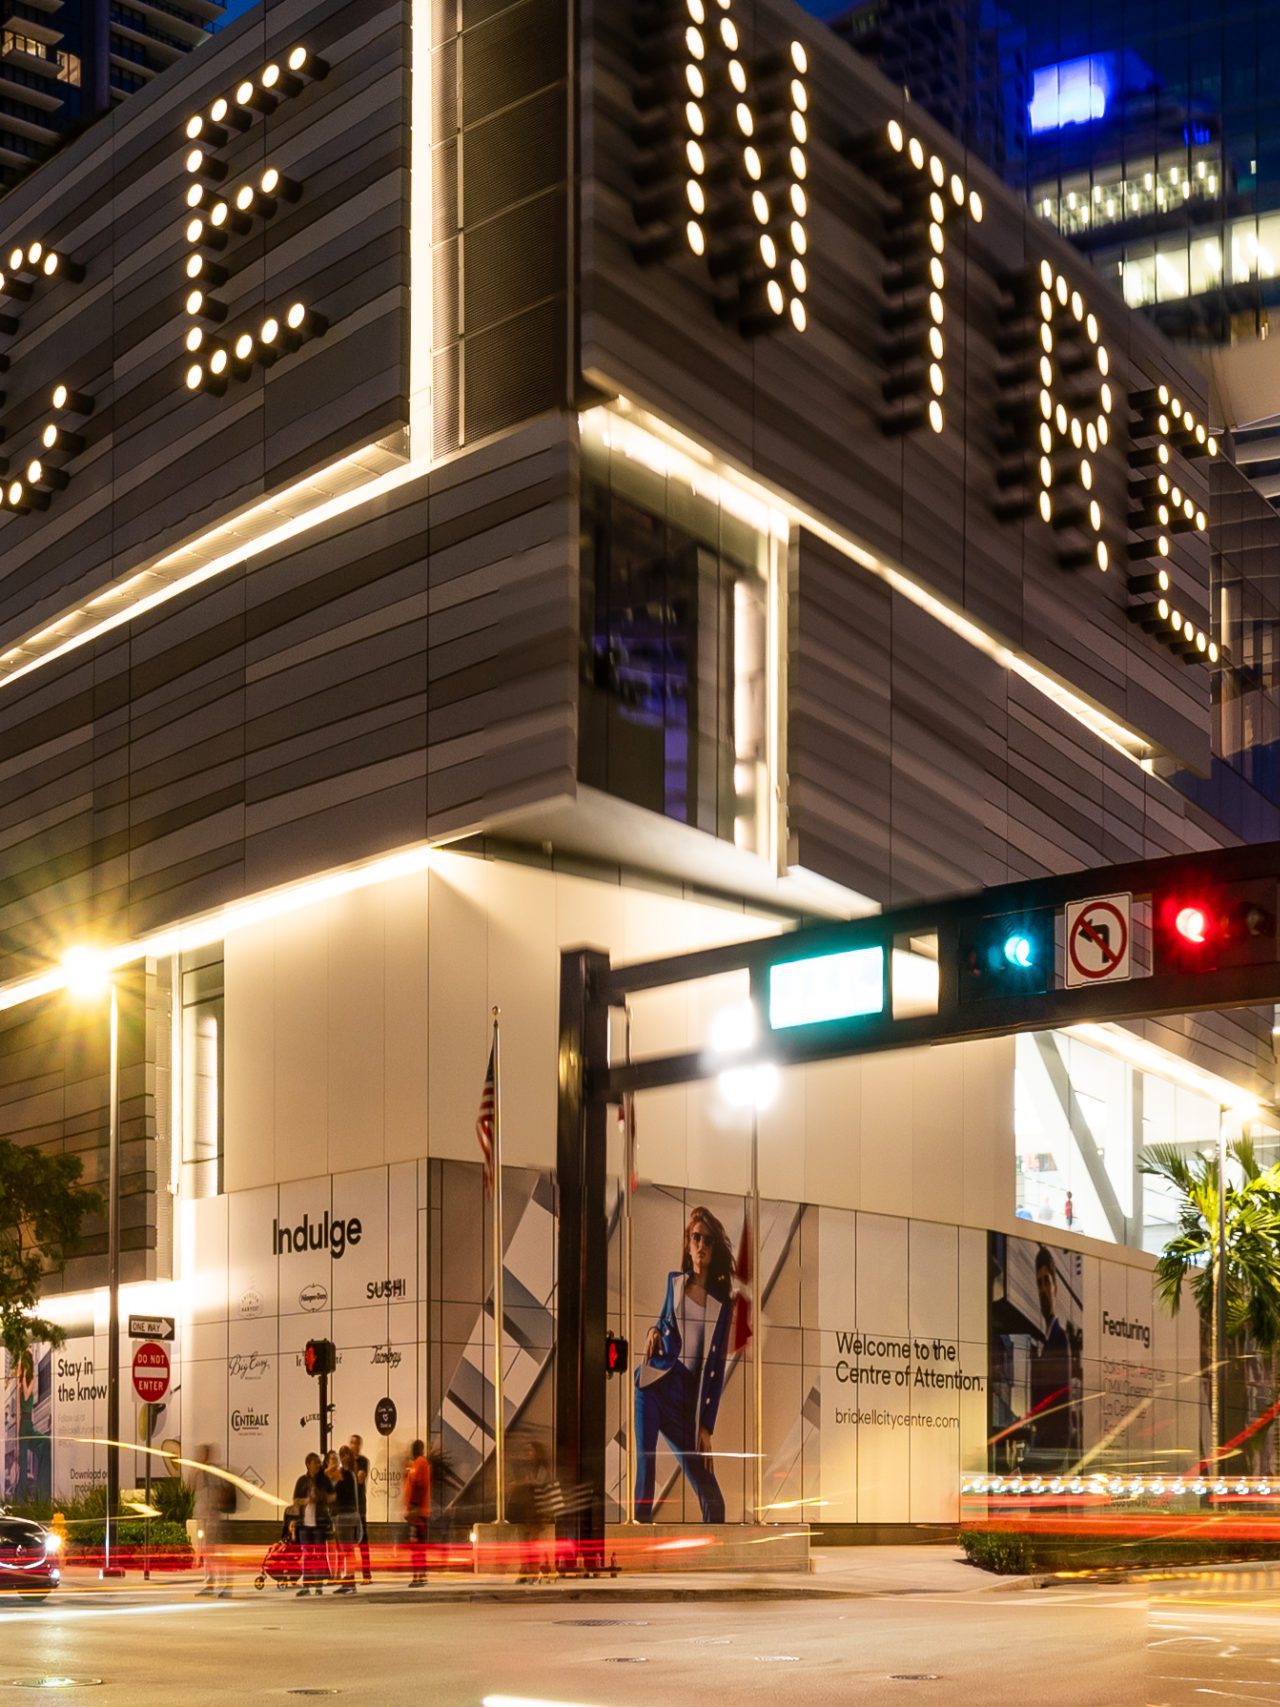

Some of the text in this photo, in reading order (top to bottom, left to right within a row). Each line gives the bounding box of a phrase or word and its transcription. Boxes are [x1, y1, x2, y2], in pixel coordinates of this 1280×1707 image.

[273, 1210, 362, 1259] Indulge
[366, 1279, 406, 1299] SUSHI
[132, 1322, 161, 1332] ONE WAY
[1102, 1311, 1150, 1349] Featuring
[836, 1331, 956, 1361] Welcome to the
[58, 1357, 93, 1381] Stay in
[138, 1354, 165, 1364] DO NOT
[230, 1354, 249, 1379] Big
[139, 1381, 164, 1391] ENTER
[836, 1361, 984, 1392] Centre of Attention.
[58, 1382, 108, 1402] the know
[231, 1410, 269, 1431] CENTRALE
[835, 1408, 960, 1430] brickellcitycentre.com
